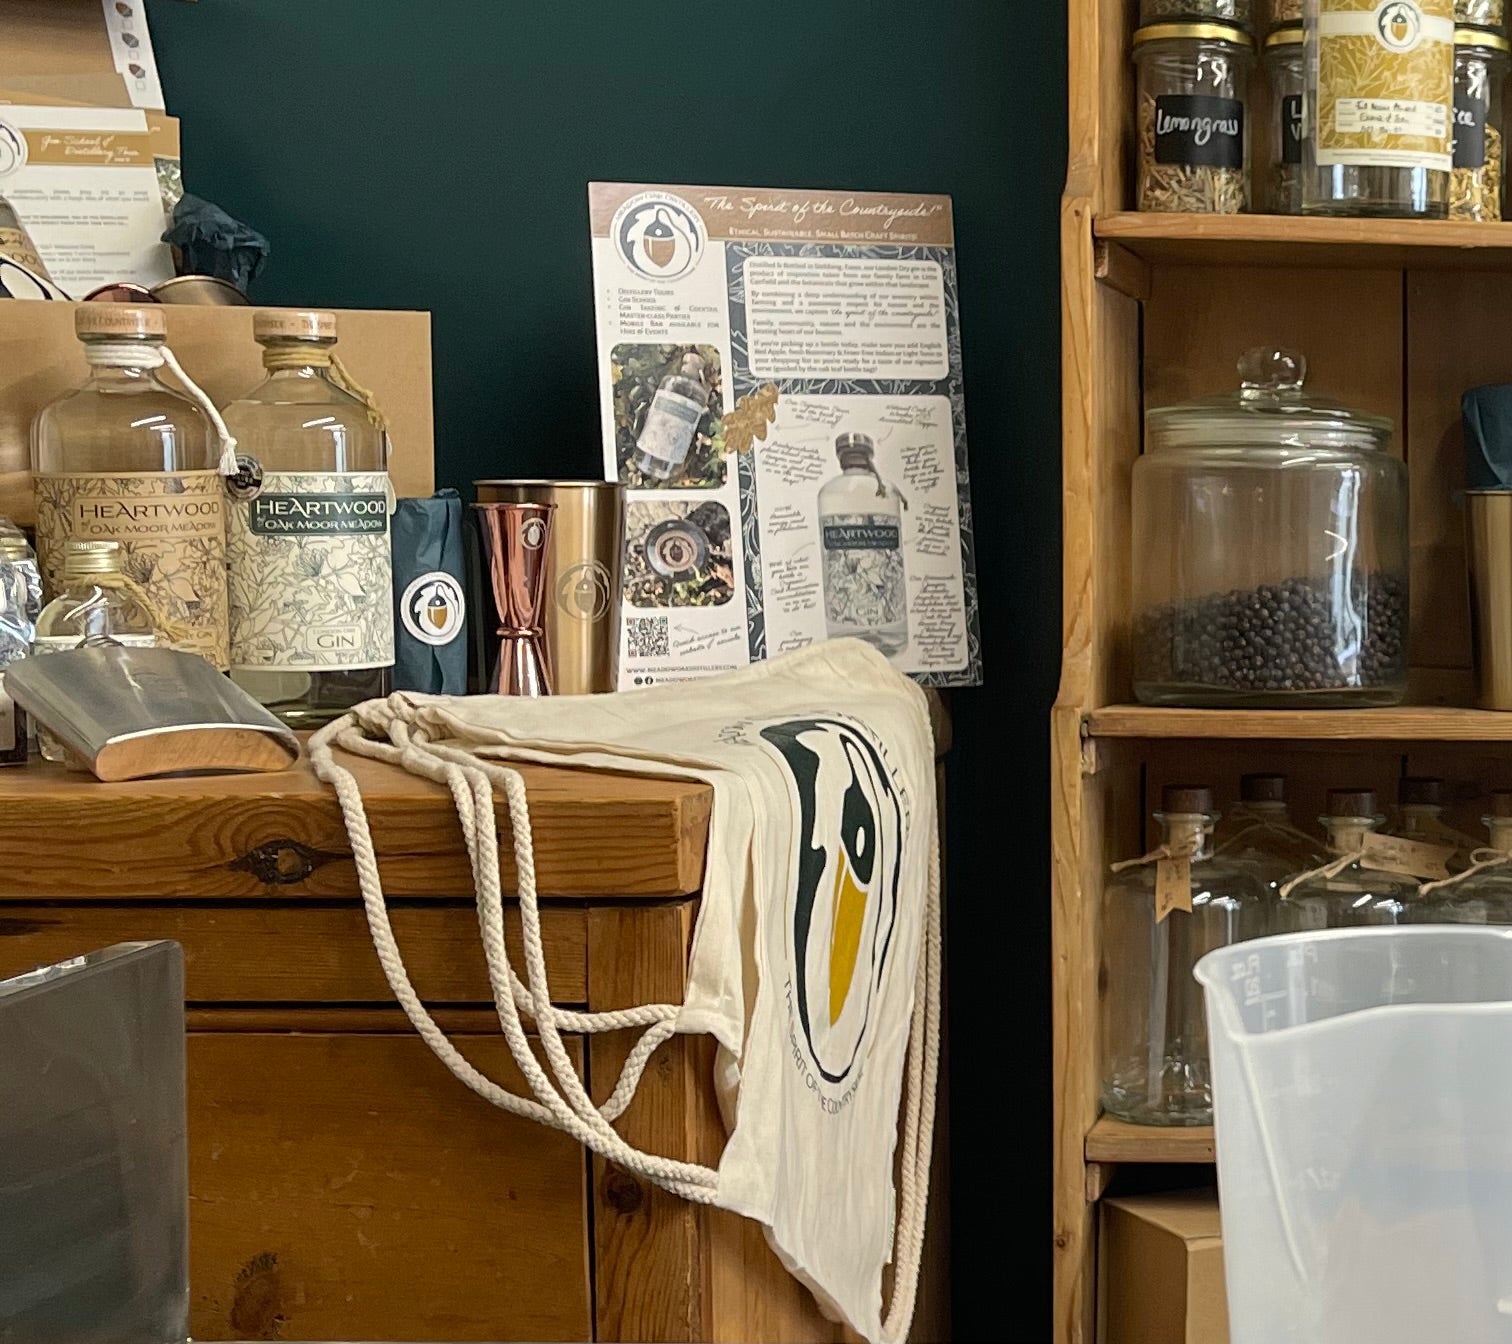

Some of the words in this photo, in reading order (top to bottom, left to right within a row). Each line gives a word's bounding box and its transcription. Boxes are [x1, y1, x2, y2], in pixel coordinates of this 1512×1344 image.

[1156, 109, 1239, 146] Lemongrass
[740, 199, 789, 220] Spirit
[790, 202, 809, 224] of
[813, 197, 837, 214] the
[79, 500, 220, 521] HEARTWOOD
[256, 499, 386, 519] HEARTWOOD
[90, 523, 121, 536] OAK
[124, 523, 168, 535] MOOR
[170, 520, 217, 533] MEADOW
[264, 521, 294, 532] OAK
[298, 520, 339, 531] MOOR
[341, 519, 383, 530] MEADOW
[316, 634, 355, 648] GIN
